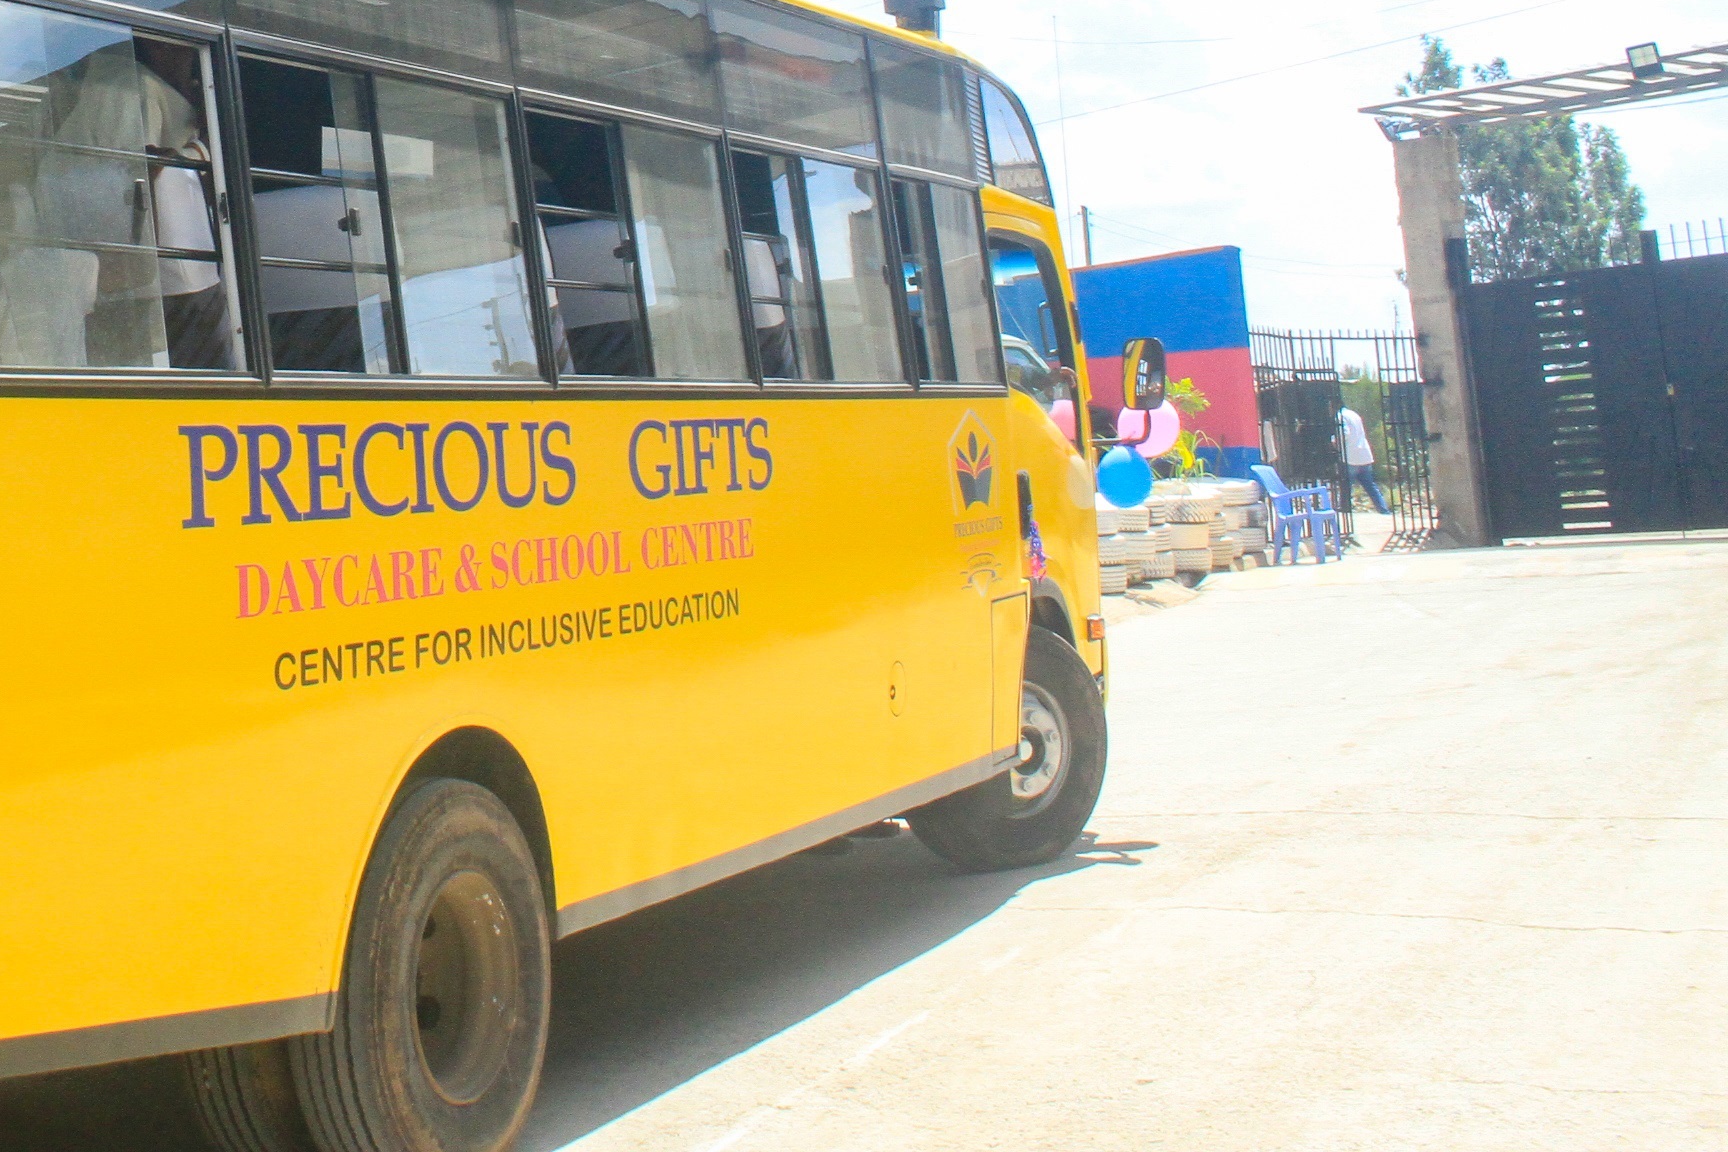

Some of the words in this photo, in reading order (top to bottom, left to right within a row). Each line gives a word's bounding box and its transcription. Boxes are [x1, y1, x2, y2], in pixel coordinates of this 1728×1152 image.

[178, 421, 576, 529] PRECIOUS
[628, 417, 773, 500] GIFTS
[235, 547, 445, 619] DAYCARE
[454, 543, 483, 593] &
[490, 530, 632, 589] SCHOOL
[640, 518, 754, 570] CENTRE
[274, 636, 406, 690] CENTRE
[415, 627, 472, 669] FOR
[480, 606, 612, 658] INCLUSIVE
[618, 588, 740, 634] EDUCATION
